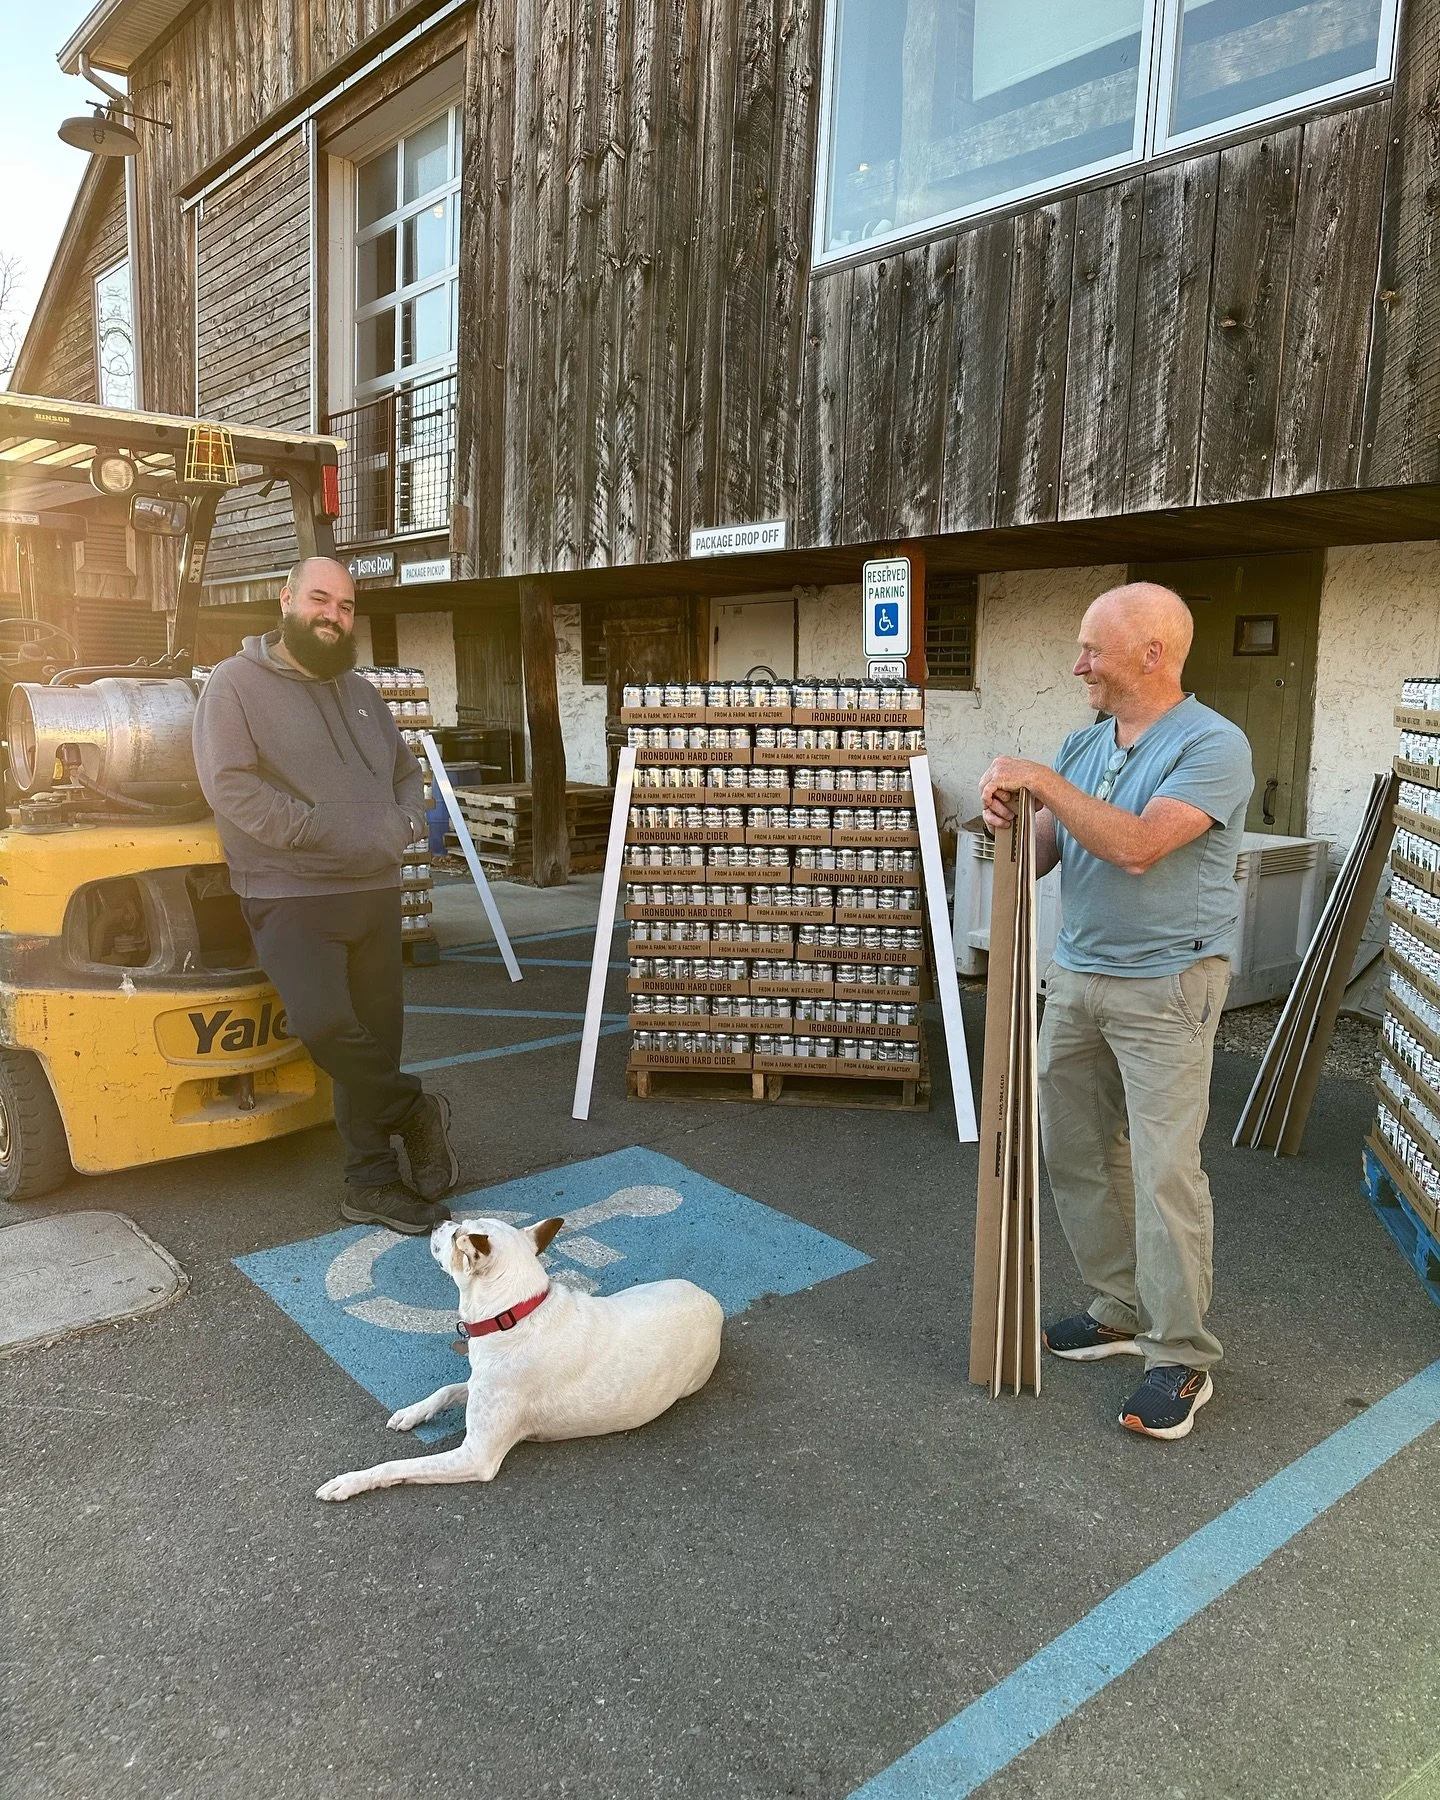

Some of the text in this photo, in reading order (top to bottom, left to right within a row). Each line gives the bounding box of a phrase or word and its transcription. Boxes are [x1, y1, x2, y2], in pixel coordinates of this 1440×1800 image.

[696, 529, 779, 550] PACKAGE DROP OFF
[406, 564, 445, 578] PACKAGE PICKUP
[868, 568, 906, 584] RESERVED
[868, 585, 904, 599] PARKING
[399, 689, 416, 697] CIDER
[812, 713, 907, 722] IRONBOUND HARD CIDER
[640, 752, 733, 761] IRONBOUND HARD CIDER
[808, 792, 903, 803] IRONBOUND HARD CIDER
[637, 832, 728, 840] IRONBOUND HARD CIDER
[811, 873, 904, 883] IRONBOUND HARD CIDER
[642, 908, 685, 916] IRONBOUND
[814, 950, 907, 962] IRONBOUND HARD CIDER
[642, 982, 732, 992] IRONBOUND HARD CIDER
[188, 1002, 294, 1054] Yale
[809, 1024, 901, 1036] IRONBOUND HARD CIDER
[647, 1055, 735, 1064] IRONBOUND HARD CIDER
